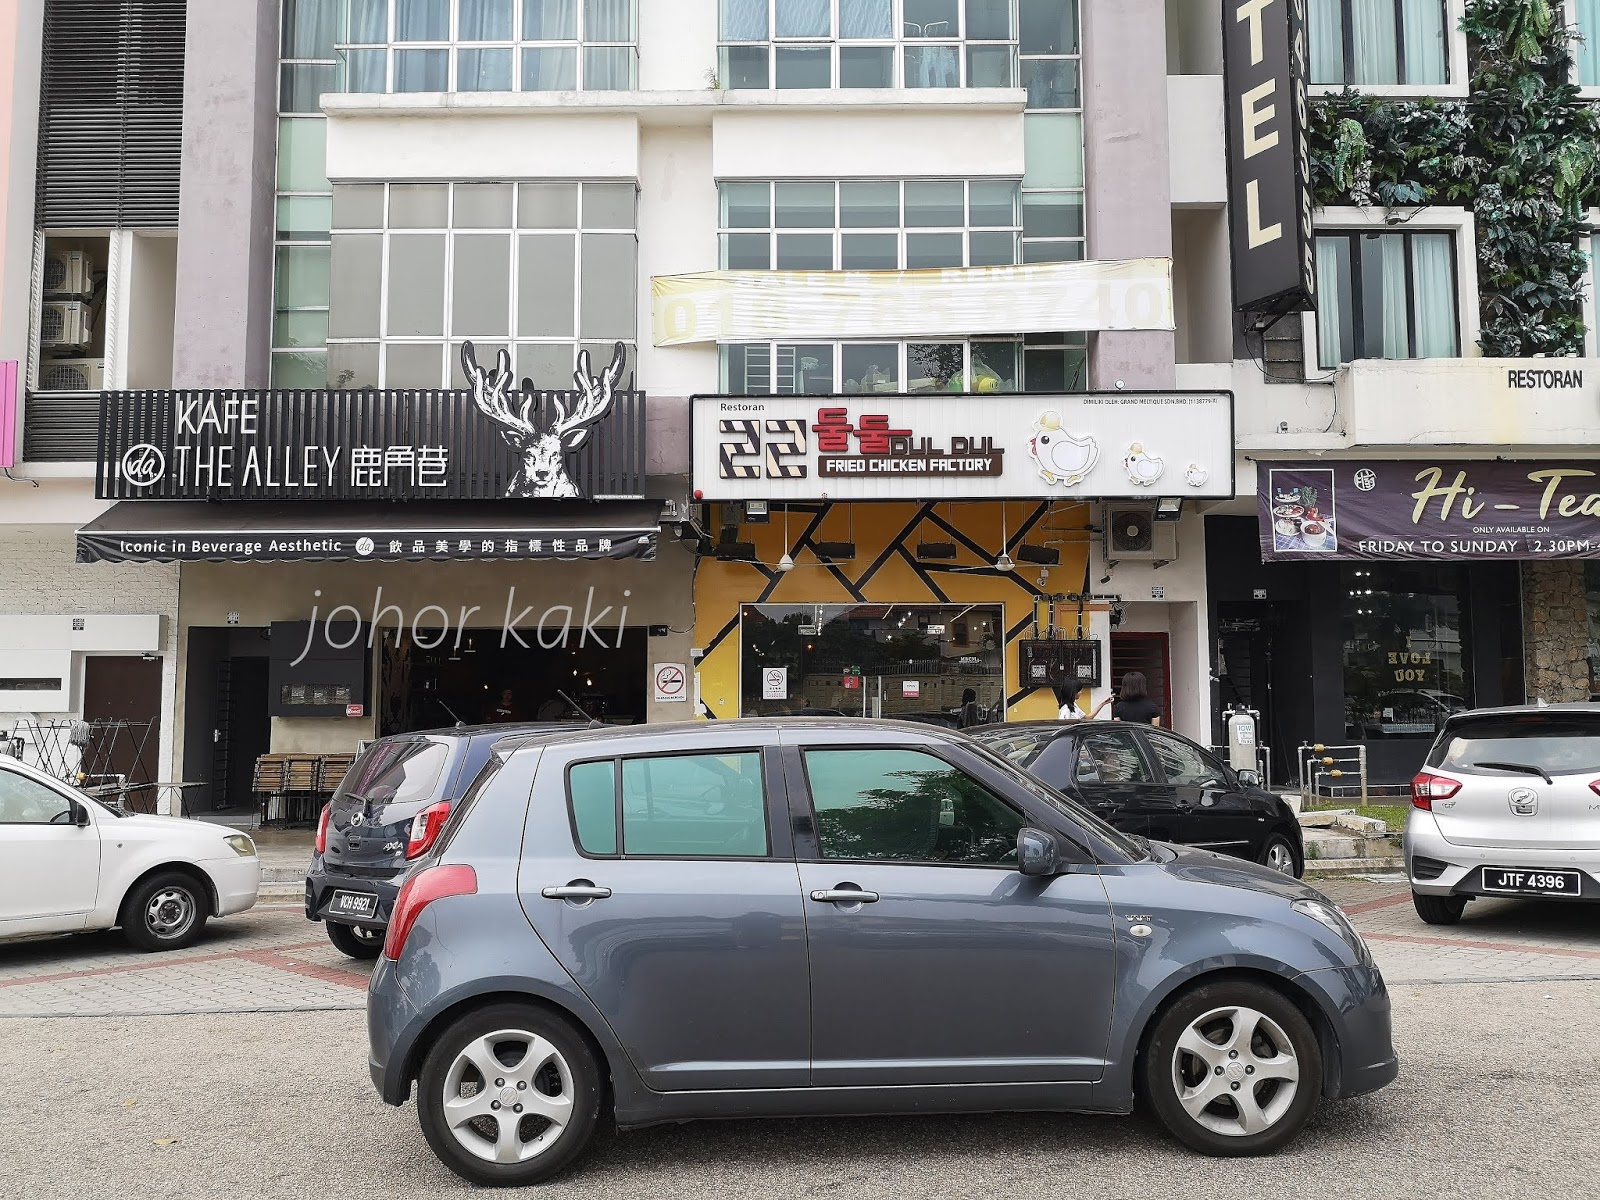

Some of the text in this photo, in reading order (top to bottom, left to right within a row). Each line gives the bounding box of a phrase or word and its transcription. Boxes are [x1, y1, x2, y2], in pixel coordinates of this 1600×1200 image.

[1508, 369, 1583, 389] RESTORAN
[720, 403, 765, 412] Restoran
[177, 400, 258, 434] KAFE
[890, 436, 1005, 454] DUL DUL
[174, 446, 233, 487] THE
[242, 446, 341, 487] ALLEY
[350, 444, 449, 487] 鹿角巷
[826, 458, 992, 472] FRIED CHICKEN FACTORY
[1412, 466, 1485, 524] Hi
[120, 538, 342, 554] Iconic in Beverage Aesthetic
[389, 538, 613, 553] 飲品美學的指標性品牌
[1359, 540, 1600, 553] FRIDAY TO SUNDAY 2.30PM-
[1498, 873, 1564, 888] JTF 4396
[352, 896, 370, 911] 9921
